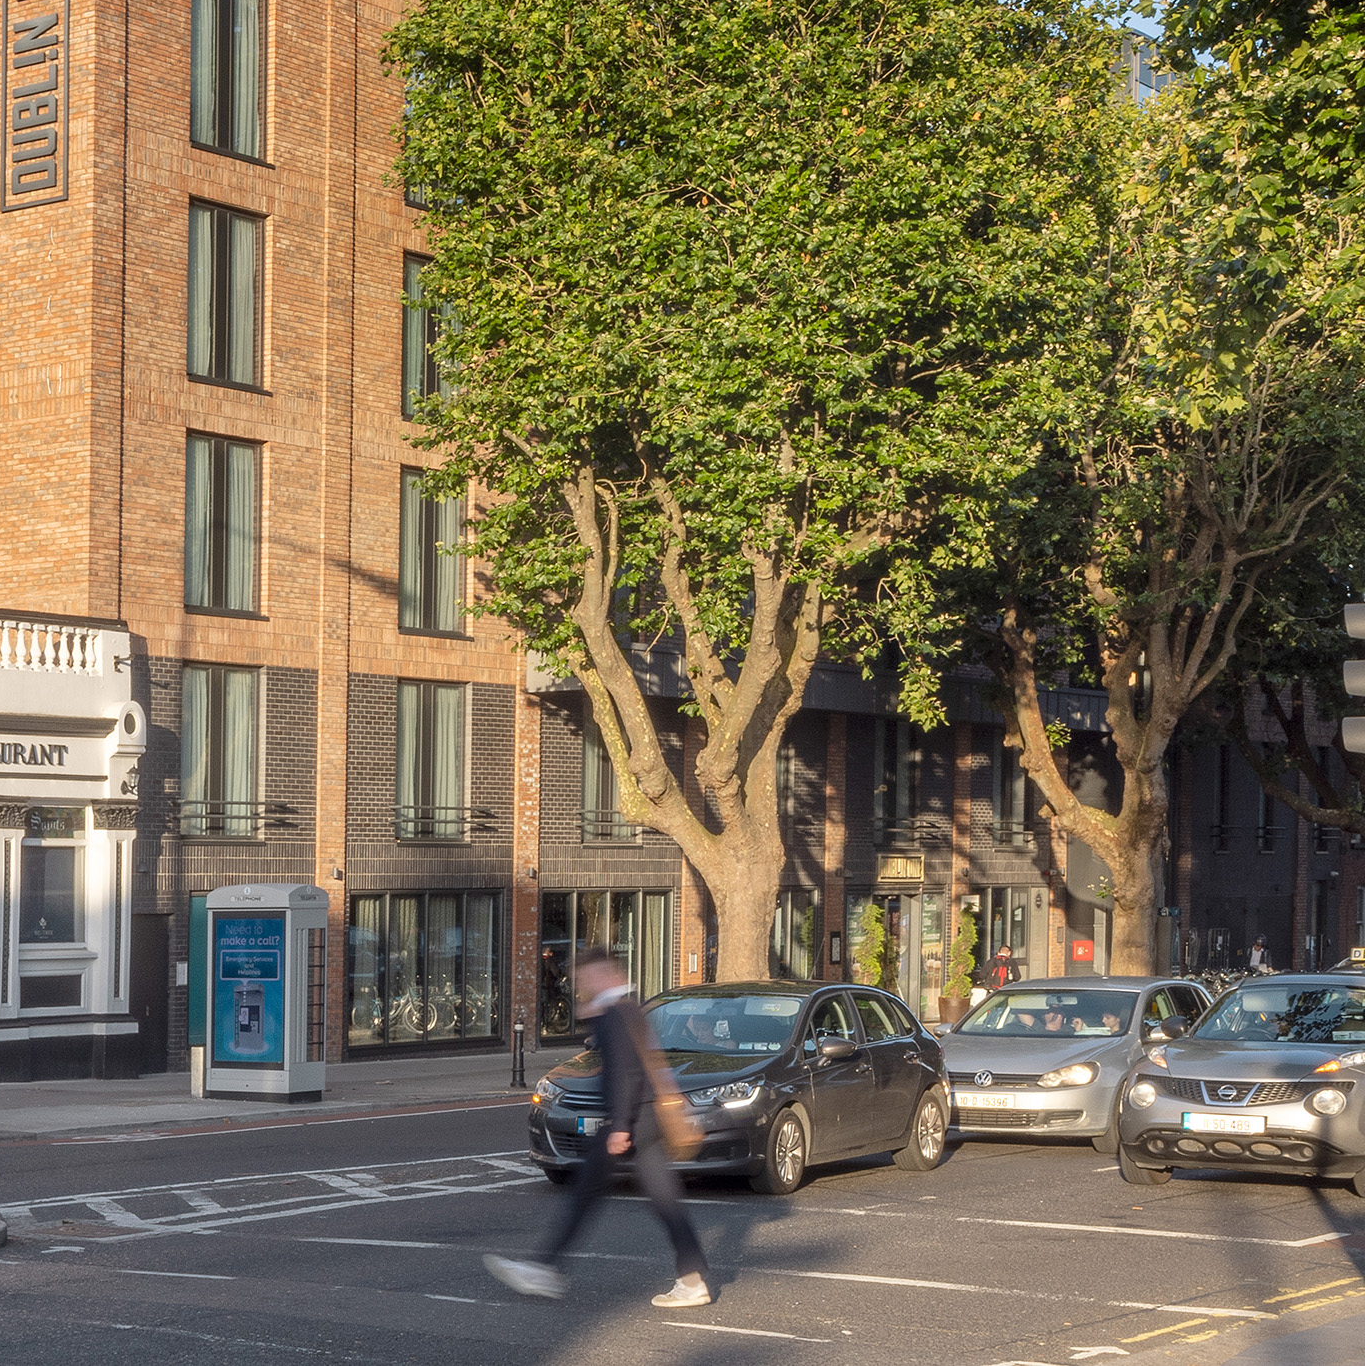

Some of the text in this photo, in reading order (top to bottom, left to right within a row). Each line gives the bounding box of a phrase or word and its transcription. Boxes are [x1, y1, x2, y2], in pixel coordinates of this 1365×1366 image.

[226, 925, 263, 934] Need to
[220, 936, 246, 945] make
[257, 936, 280, 945] call?
